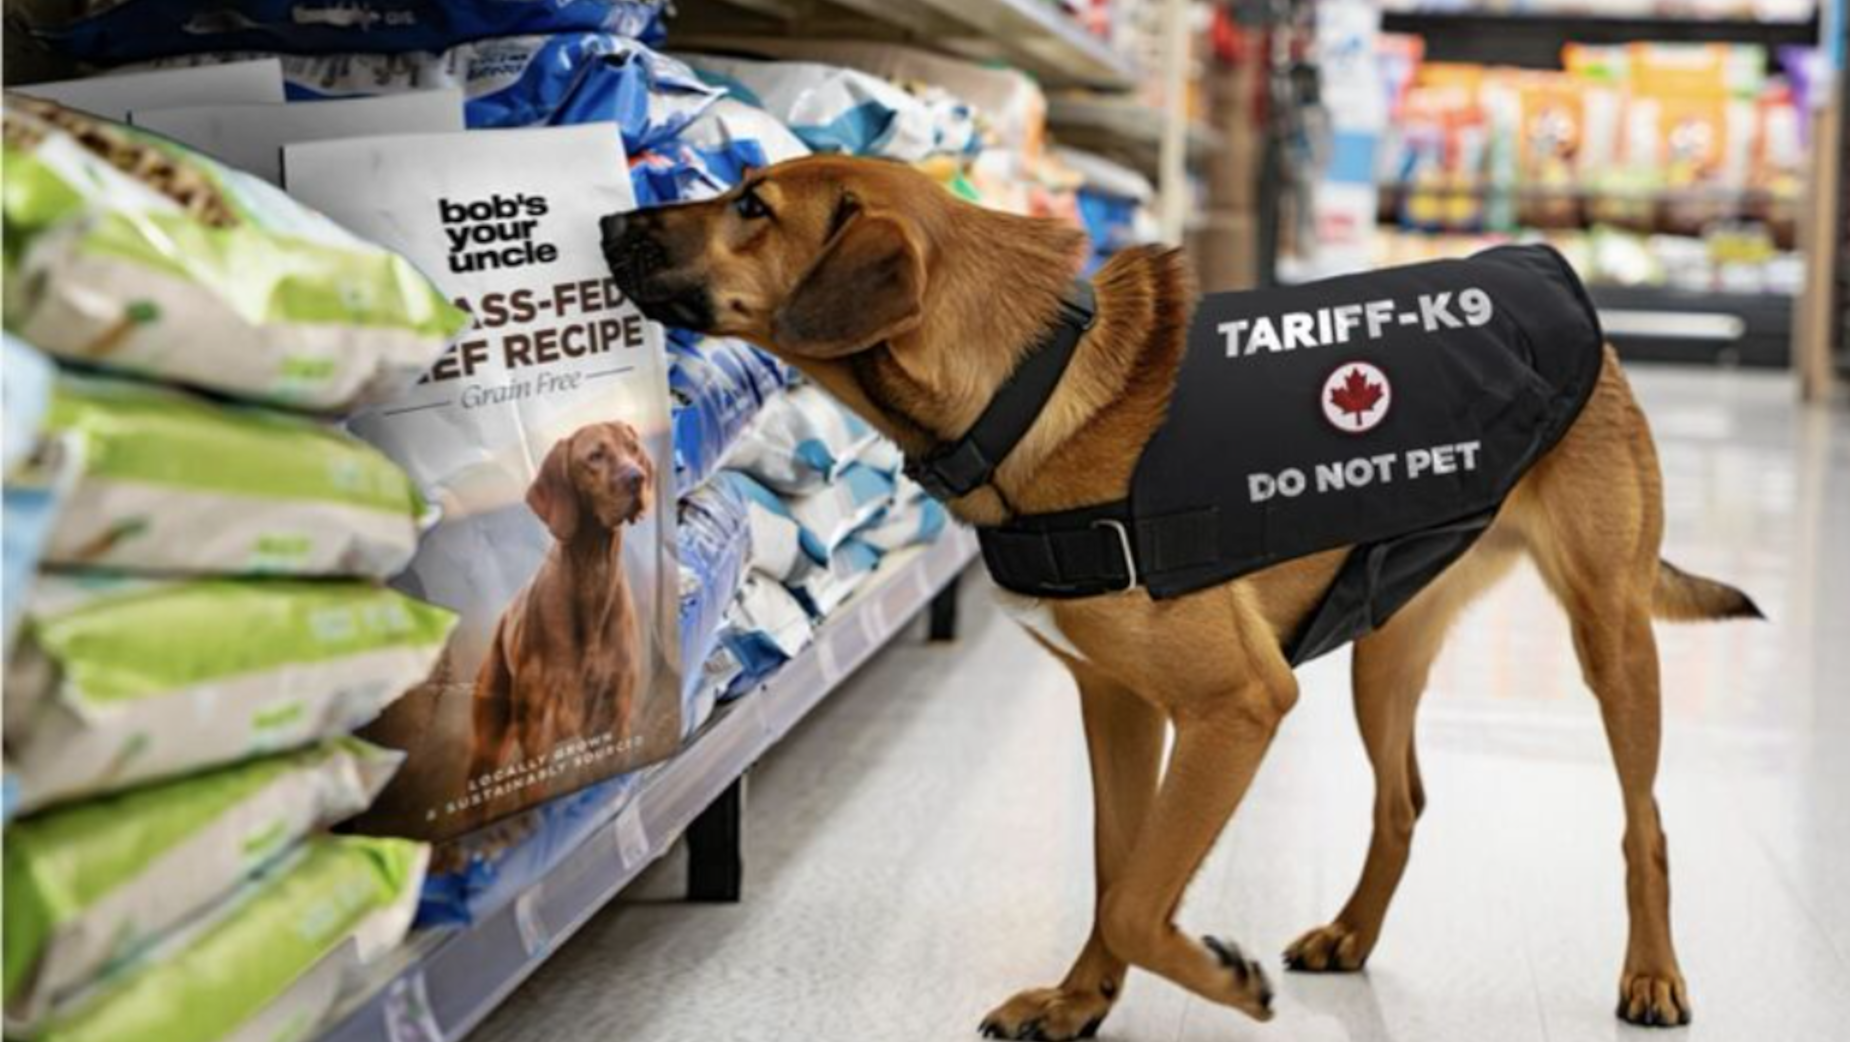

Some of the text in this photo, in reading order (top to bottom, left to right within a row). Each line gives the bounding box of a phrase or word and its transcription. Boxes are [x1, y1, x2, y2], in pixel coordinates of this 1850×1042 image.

[438, 194, 549, 224] bob's
[445, 220, 538, 254] your
[448, 242, 558, 273] uncle
[1217, 287, 1493, 358] TARIFF-K9
[503, 315, 643, 369] RECIPE
[459, 369, 582, 409] Grain Free
[1248, 441, 1481, 502] DO NOT PET
[468, 755, 547, 791] LOCALLY
